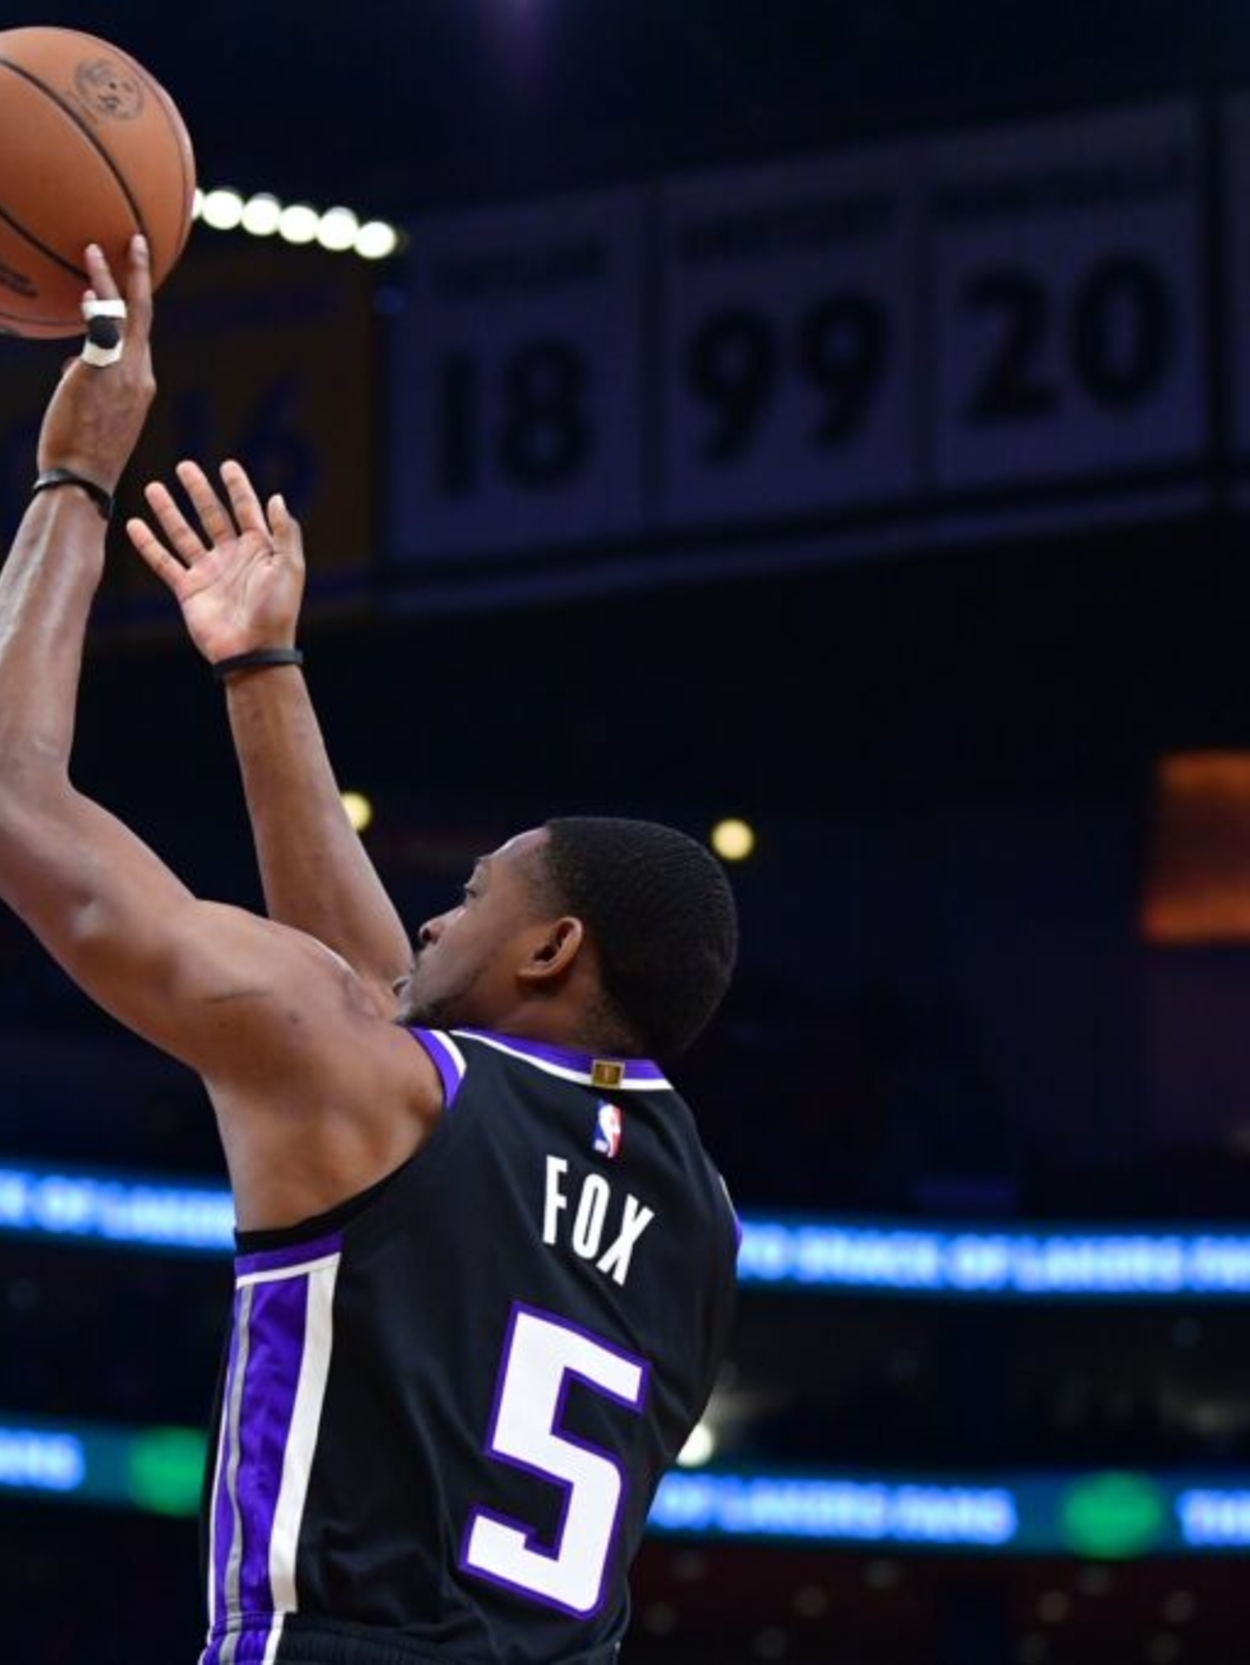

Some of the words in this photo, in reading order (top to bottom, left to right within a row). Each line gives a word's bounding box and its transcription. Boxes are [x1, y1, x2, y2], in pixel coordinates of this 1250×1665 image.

[440, 338, 592, 494] 18
[688, 292, 890, 470] 99
[960, 253, 1176, 428] 20
[543, 1154, 655, 1287] FOX
[458, 1302, 650, 1620] 5
